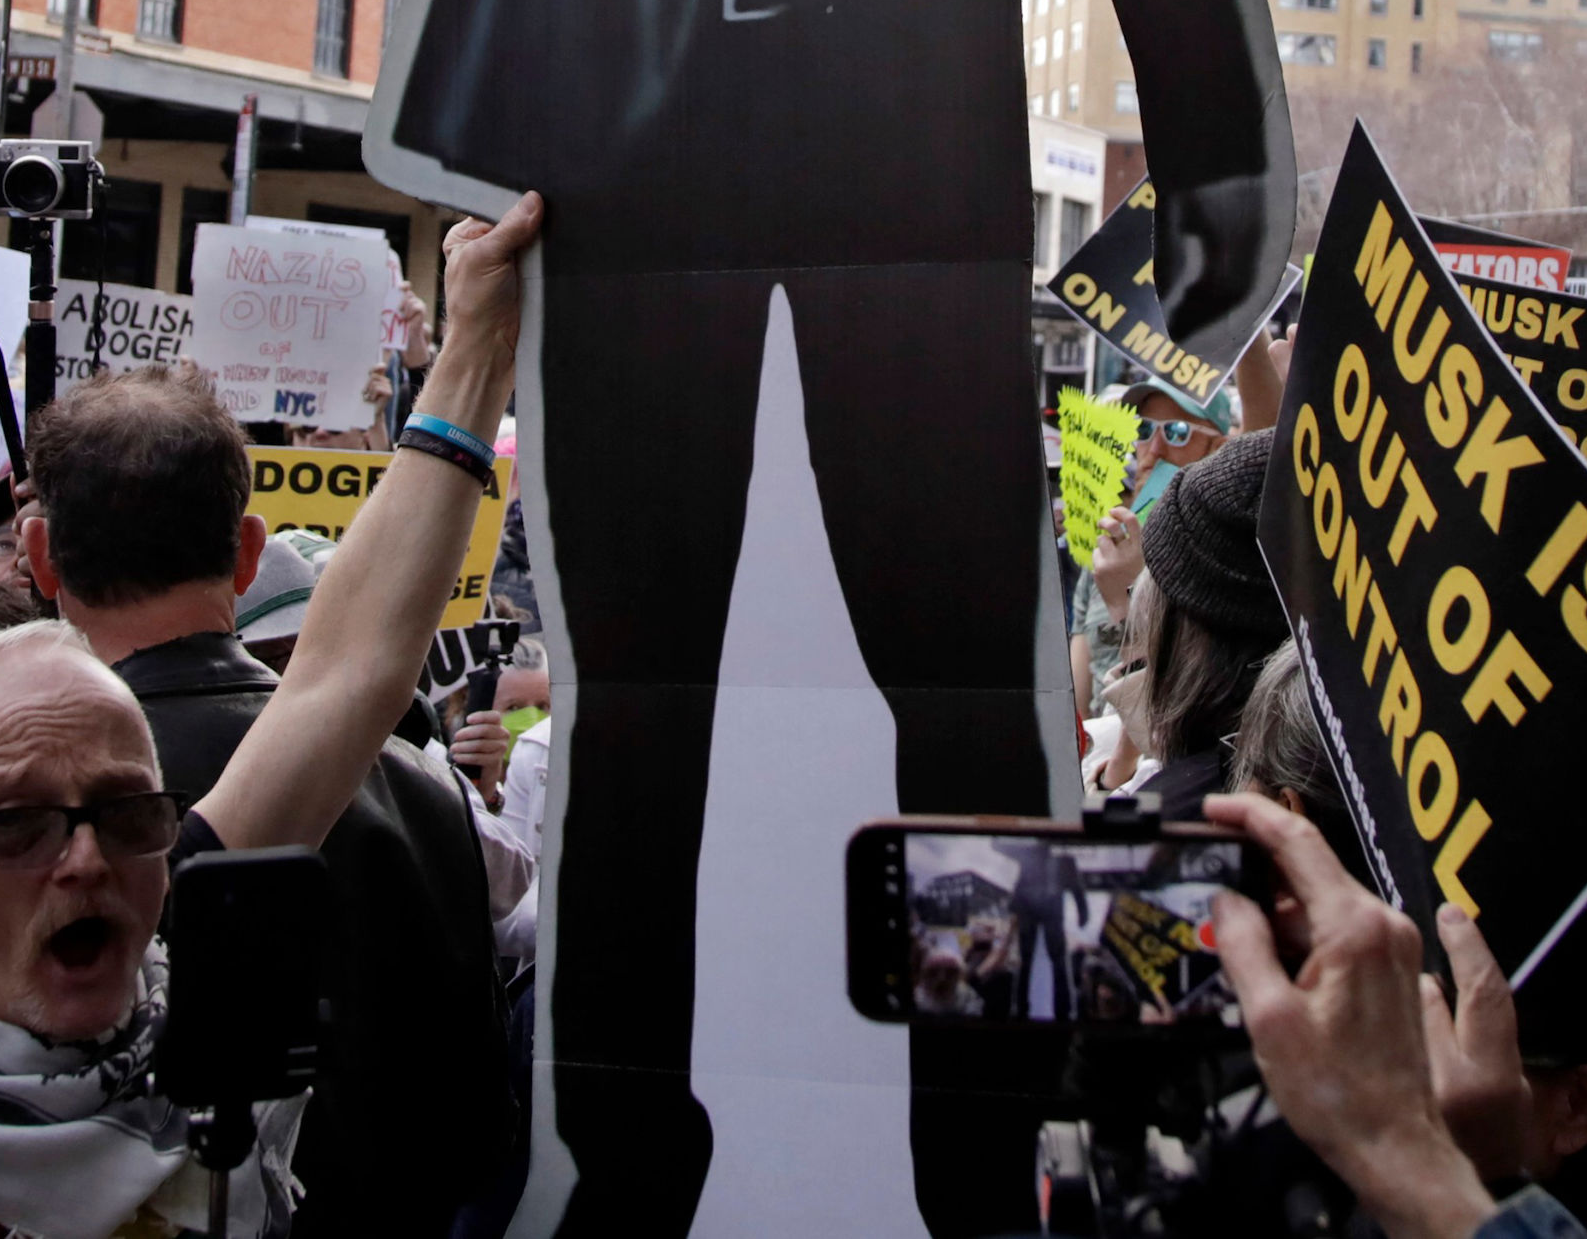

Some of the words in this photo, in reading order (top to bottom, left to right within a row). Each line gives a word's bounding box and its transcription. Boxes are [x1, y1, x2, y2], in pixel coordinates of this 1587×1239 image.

[220, 291, 349, 340] OUT
[1063, 272, 1126, 333] ON
[1122, 321, 1221, 398] MUSK
[1354, 199, 1546, 533] MUSK
[1460, 283, 1586, 350] MUSK
[1333, 343, 1439, 568] OUT
[1427, 565, 1553, 727] OF
[1292, 403, 1493, 920] CONTROL
